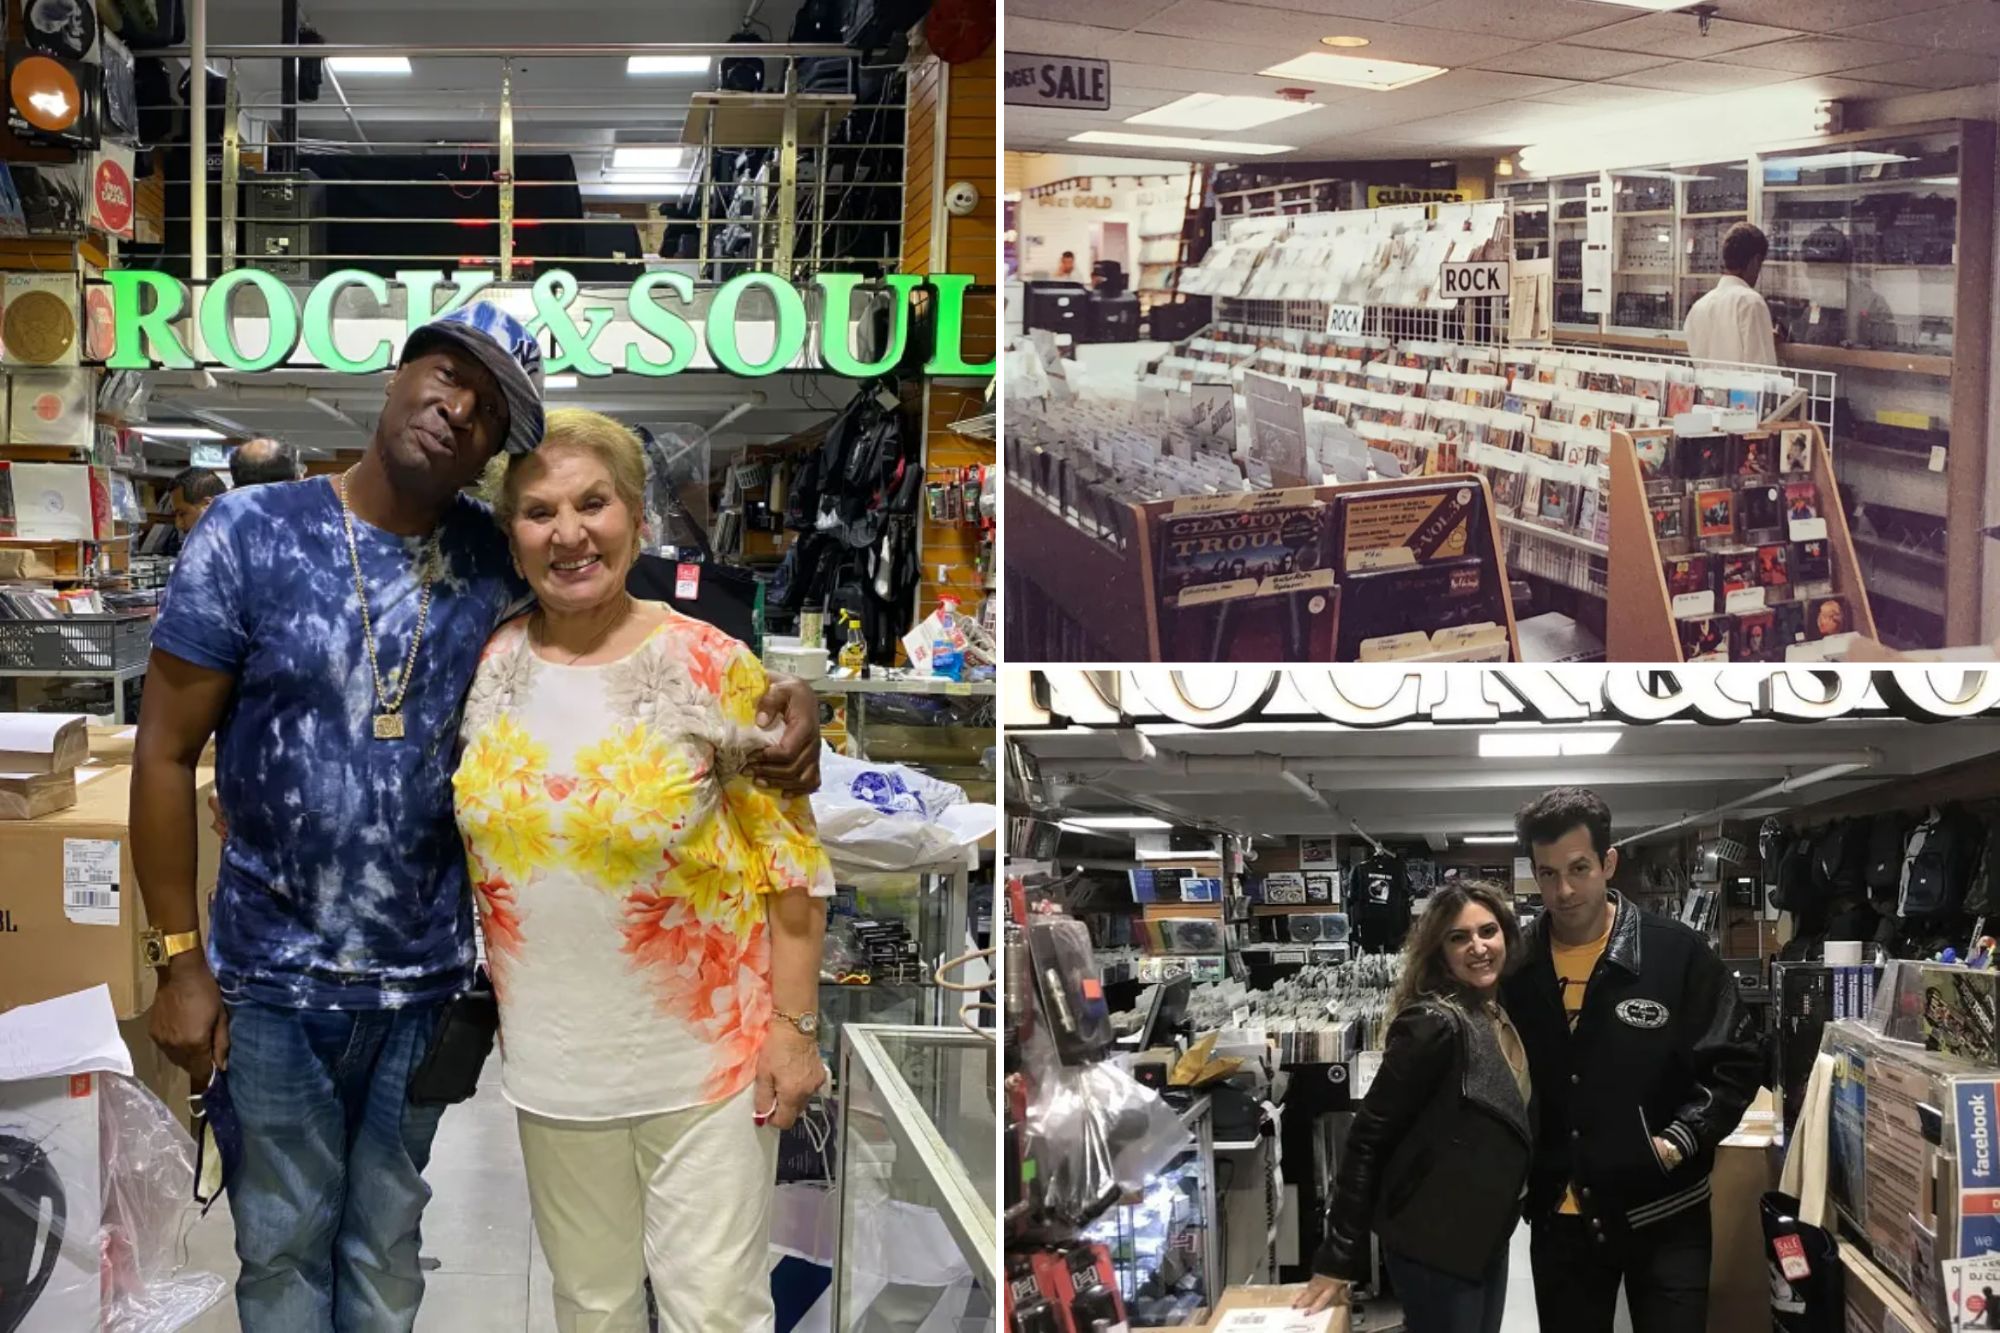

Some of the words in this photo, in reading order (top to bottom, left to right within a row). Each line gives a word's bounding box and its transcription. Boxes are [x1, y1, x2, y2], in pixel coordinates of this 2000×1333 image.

[1039, 64, 1105, 102] SALE
[1073, 195, 1112, 209] GOLD
[1445, 268, 1501, 292] ROCK
[103, 268, 495, 374] ROCK
[1330, 309, 1360, 332] ROCK
[1967, 1093, 1991, 1178] facebook
[1776, 1237, 1799, 1252] SALE
